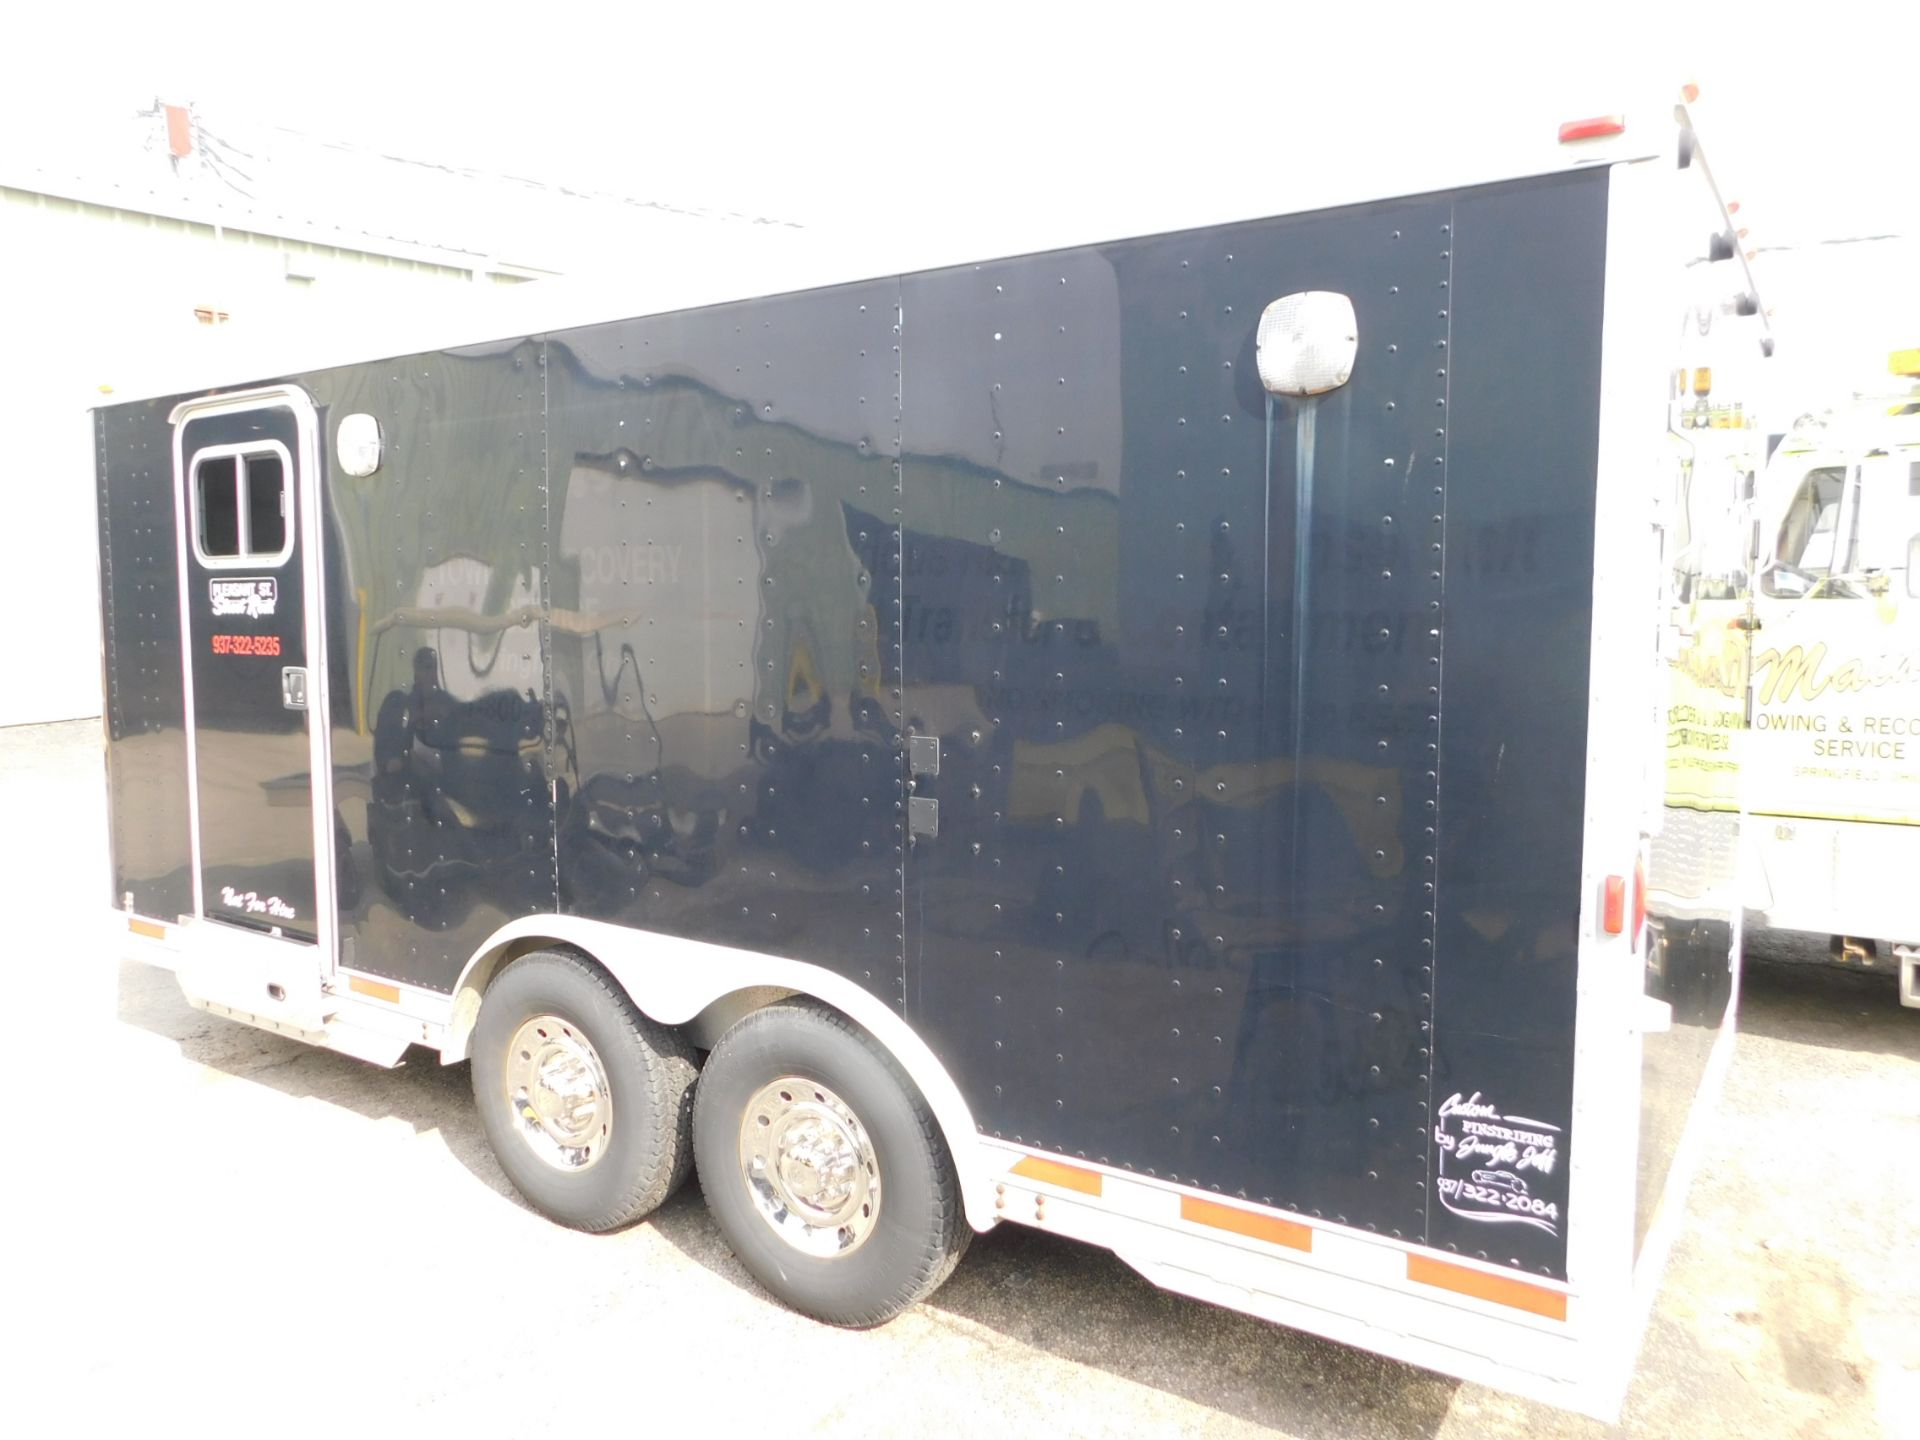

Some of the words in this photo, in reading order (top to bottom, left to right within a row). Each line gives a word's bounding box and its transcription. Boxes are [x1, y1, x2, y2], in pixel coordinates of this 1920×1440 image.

[211, 634, 281, 657] 937-322-5235
[1755, 712, 1827, 733] OWING
[1838, 716, 1853, 734] &
[1813, 738, 1907, 761] SERVICE
[1438, 1091, 1502, 1120] Custom
[1434, 1124, 1456, 1150] by
[1461, 1119, 1555, 1148] PINSTRIPING
